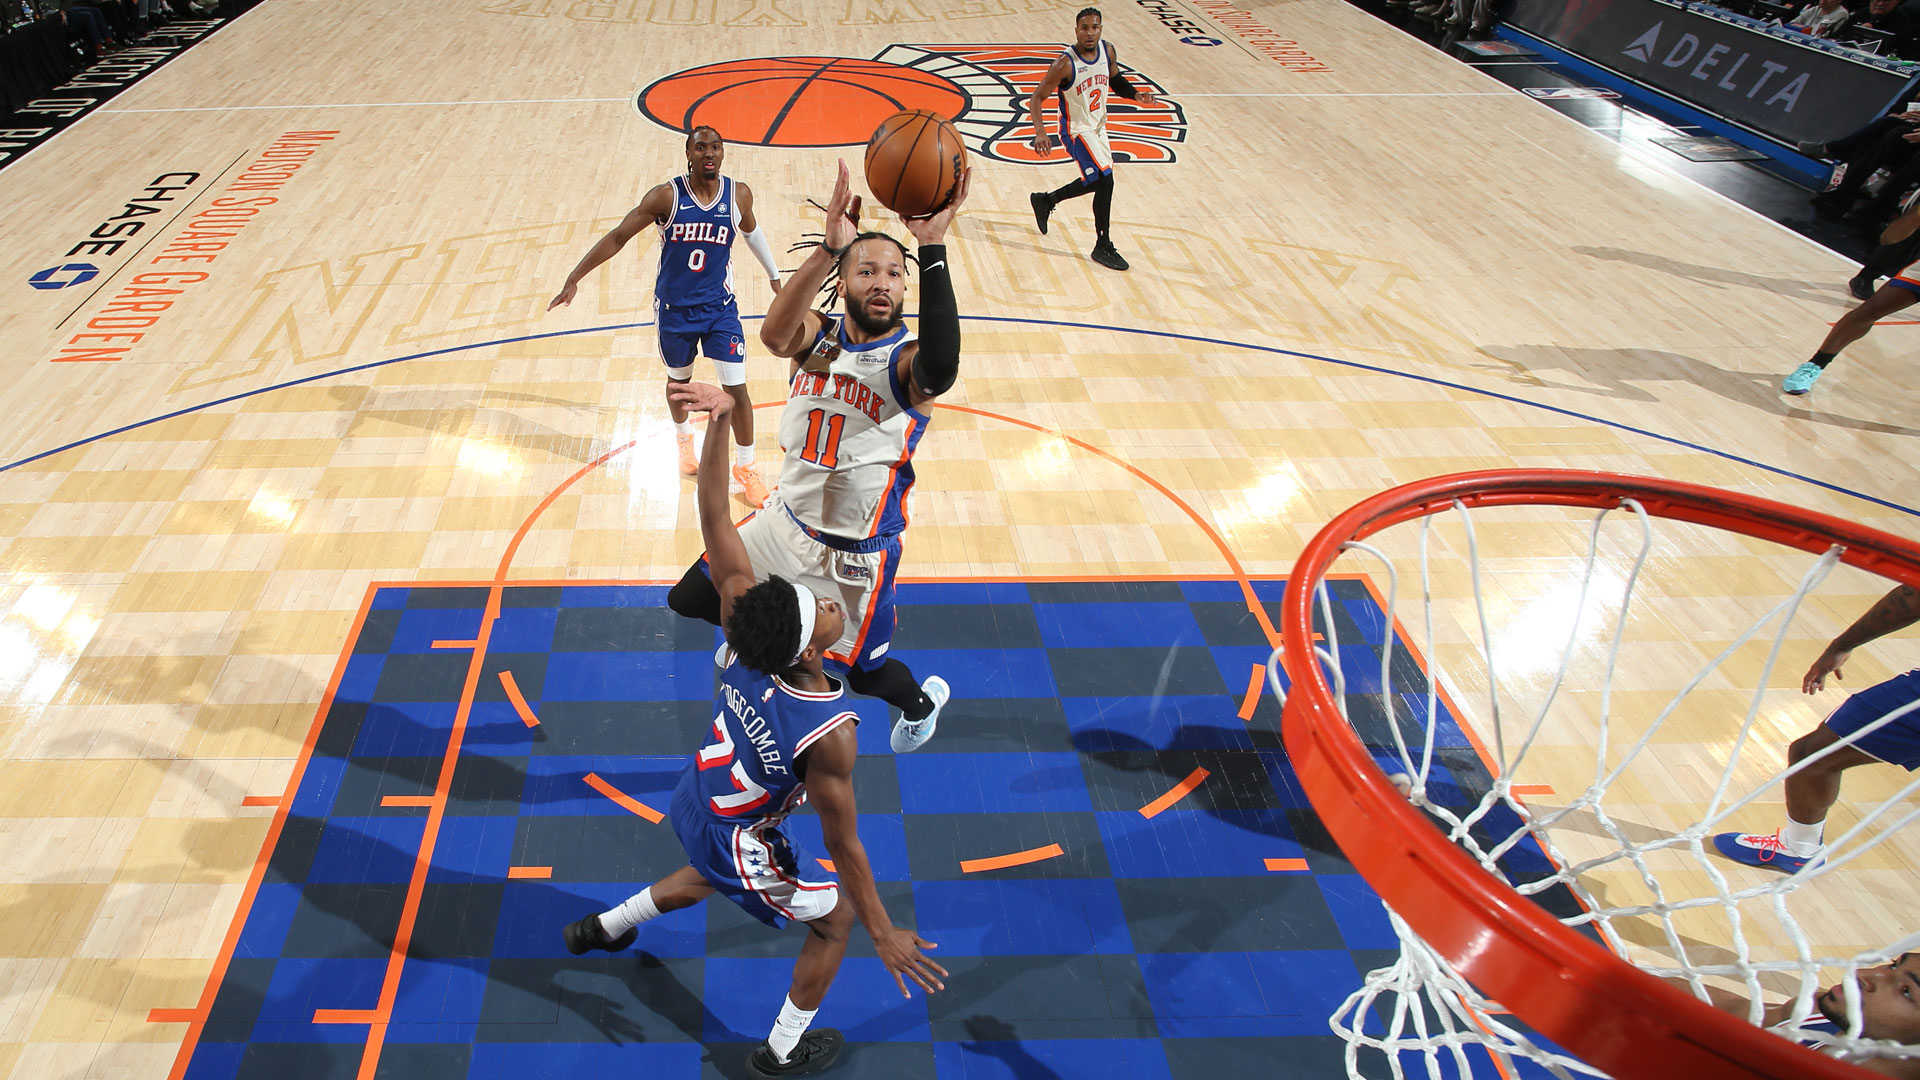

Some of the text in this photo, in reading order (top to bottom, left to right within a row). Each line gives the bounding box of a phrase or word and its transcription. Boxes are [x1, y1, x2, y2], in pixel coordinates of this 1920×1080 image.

[1136, 0, 1206, 35] CHASE
[1208, 10, 1281, 37] SQUARE
[1249, 40, 1335, 73] GARDEN
[52, 45, 183, 91] MECCA
[1075, 76, 1093, 96] NEW
[1661, 32, 1811, 114] DELTA
[1872, 60, 1889, 69] CHASE
[1896, 66, 1913, 75] CHASE
[14, 98, 98, 117] OF
[1089, 88, 1102, 112] 2
[64, 171, 201, 257] CHASE
[671, 222, 729, 245] PHILA
[50, 130, 341, 363] MADISON SQUARE GARDEN
[688, 248, 706, 273] 0
[729, 342, 745, 356] 76
[790, 371, 886, 426] NEW YORK
[800, 407, 846, 470] 11
[720, 682, 789, 775] DGECOMBE
[695, 710, 771, 816] 77
